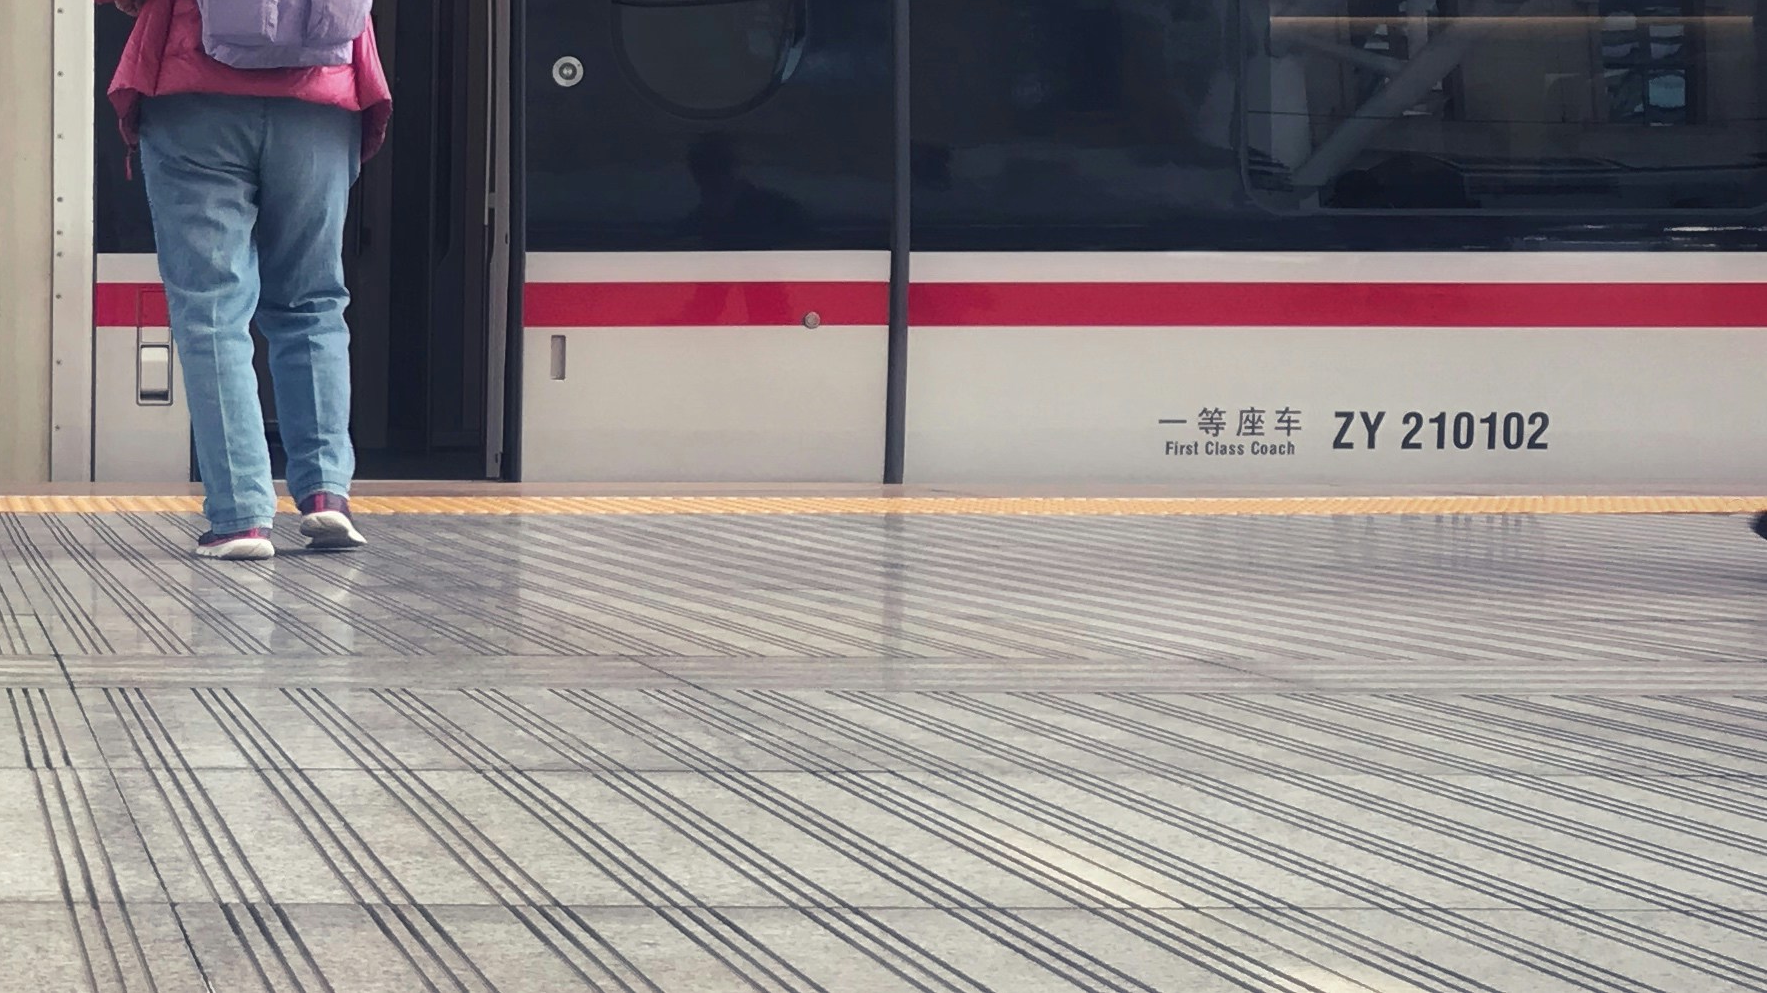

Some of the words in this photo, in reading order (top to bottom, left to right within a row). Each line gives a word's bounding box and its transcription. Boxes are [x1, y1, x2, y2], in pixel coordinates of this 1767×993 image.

[1159, 407, 1302, 437] 一等座车
[1333, 411, 1386, 449] ZY
[1401, 411, 1550, 450] 210102
[1165, 441, 1199, 456] First
[1205, 441, 1245, 456] Class
[1250, 441, 1295, 456] Coach
